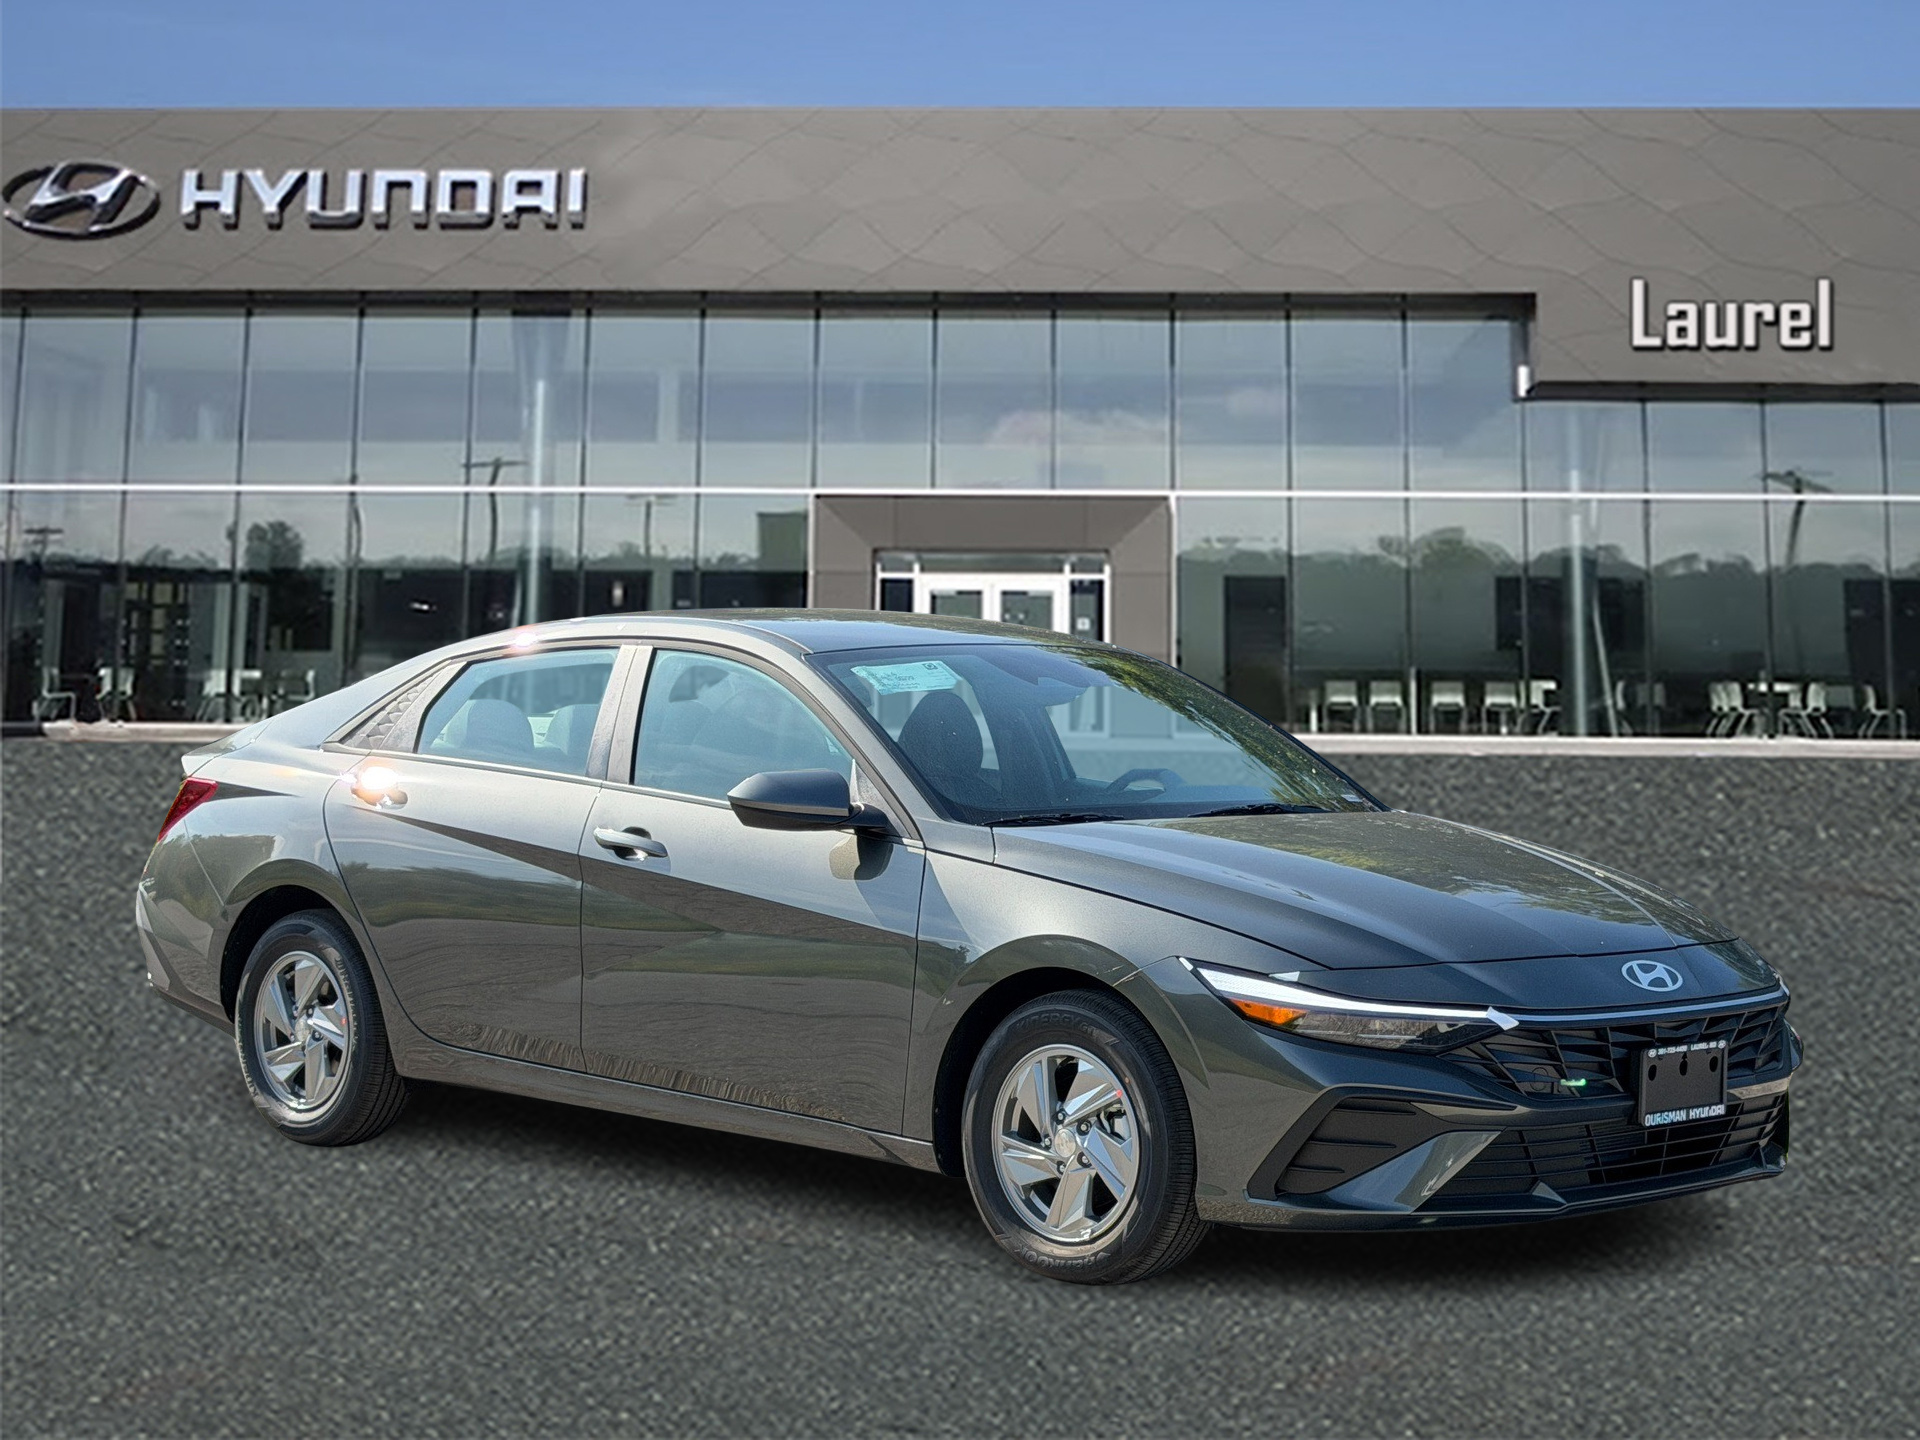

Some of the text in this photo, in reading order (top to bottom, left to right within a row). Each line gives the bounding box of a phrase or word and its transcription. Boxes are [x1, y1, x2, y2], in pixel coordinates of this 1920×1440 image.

[181, 168, 587, 230] HYUNDAI
[1631, 278, 1832, 348] Laurel
[1645, 1104, 1724, 1126] OURISMAN HYUNDAI
